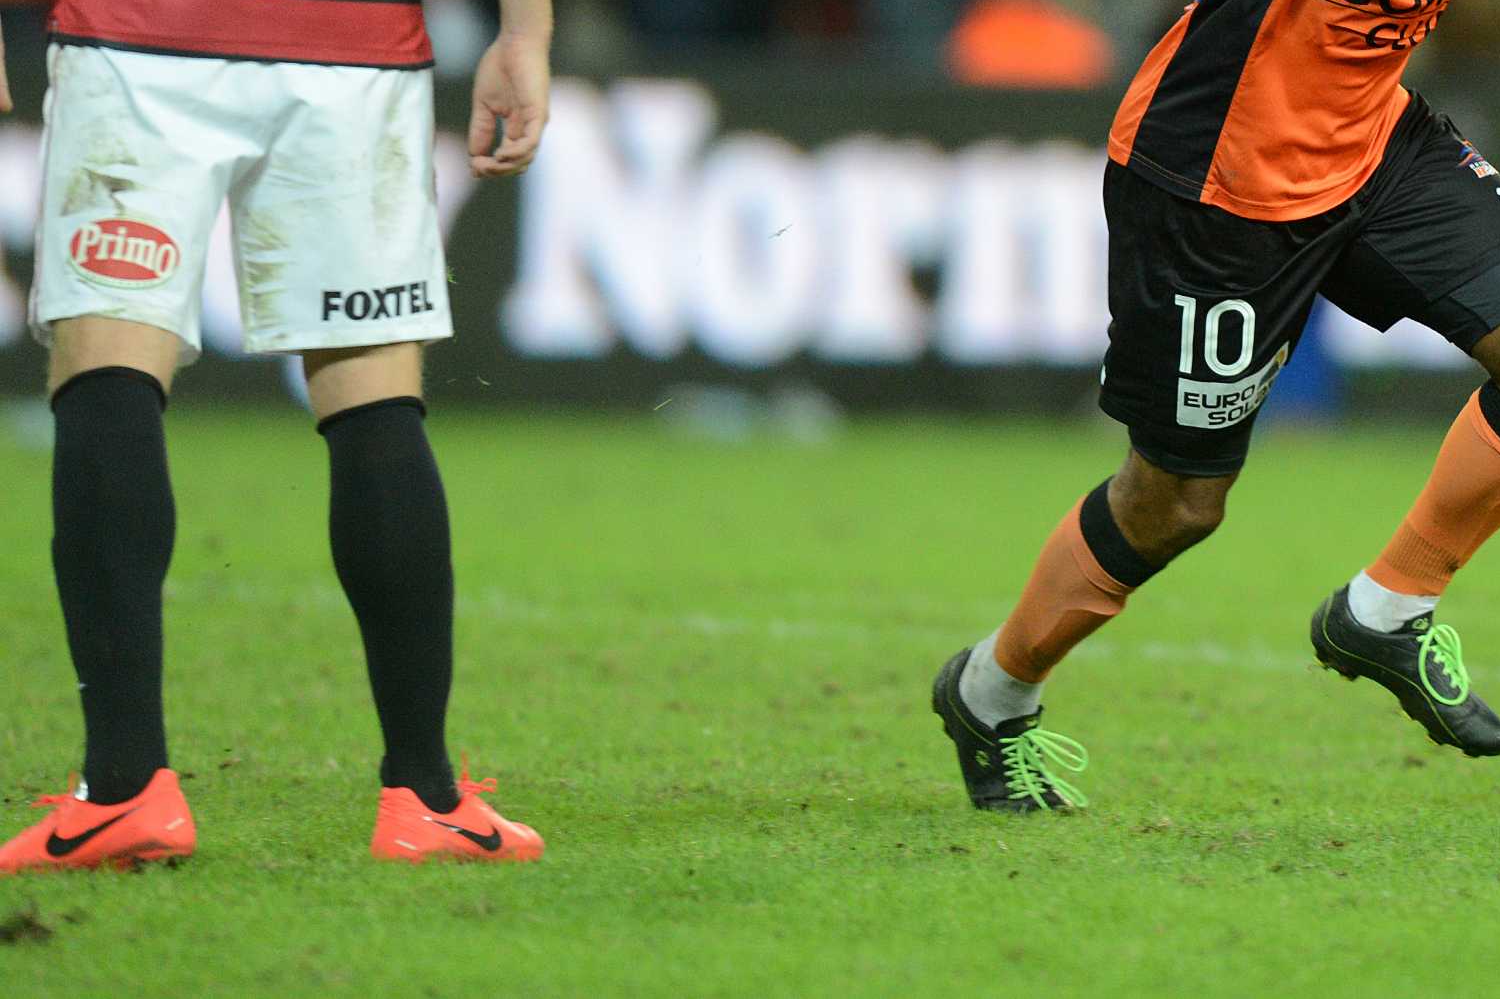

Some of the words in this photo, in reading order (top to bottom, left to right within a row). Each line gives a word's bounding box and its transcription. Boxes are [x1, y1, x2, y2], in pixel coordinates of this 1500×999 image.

[76, 224, 176, 278] Primo
[322, 280, 433, 321] FOXTEL
[1174, 293, 1256, 377] 10
[1183, 384, 1256, 409] EURO
